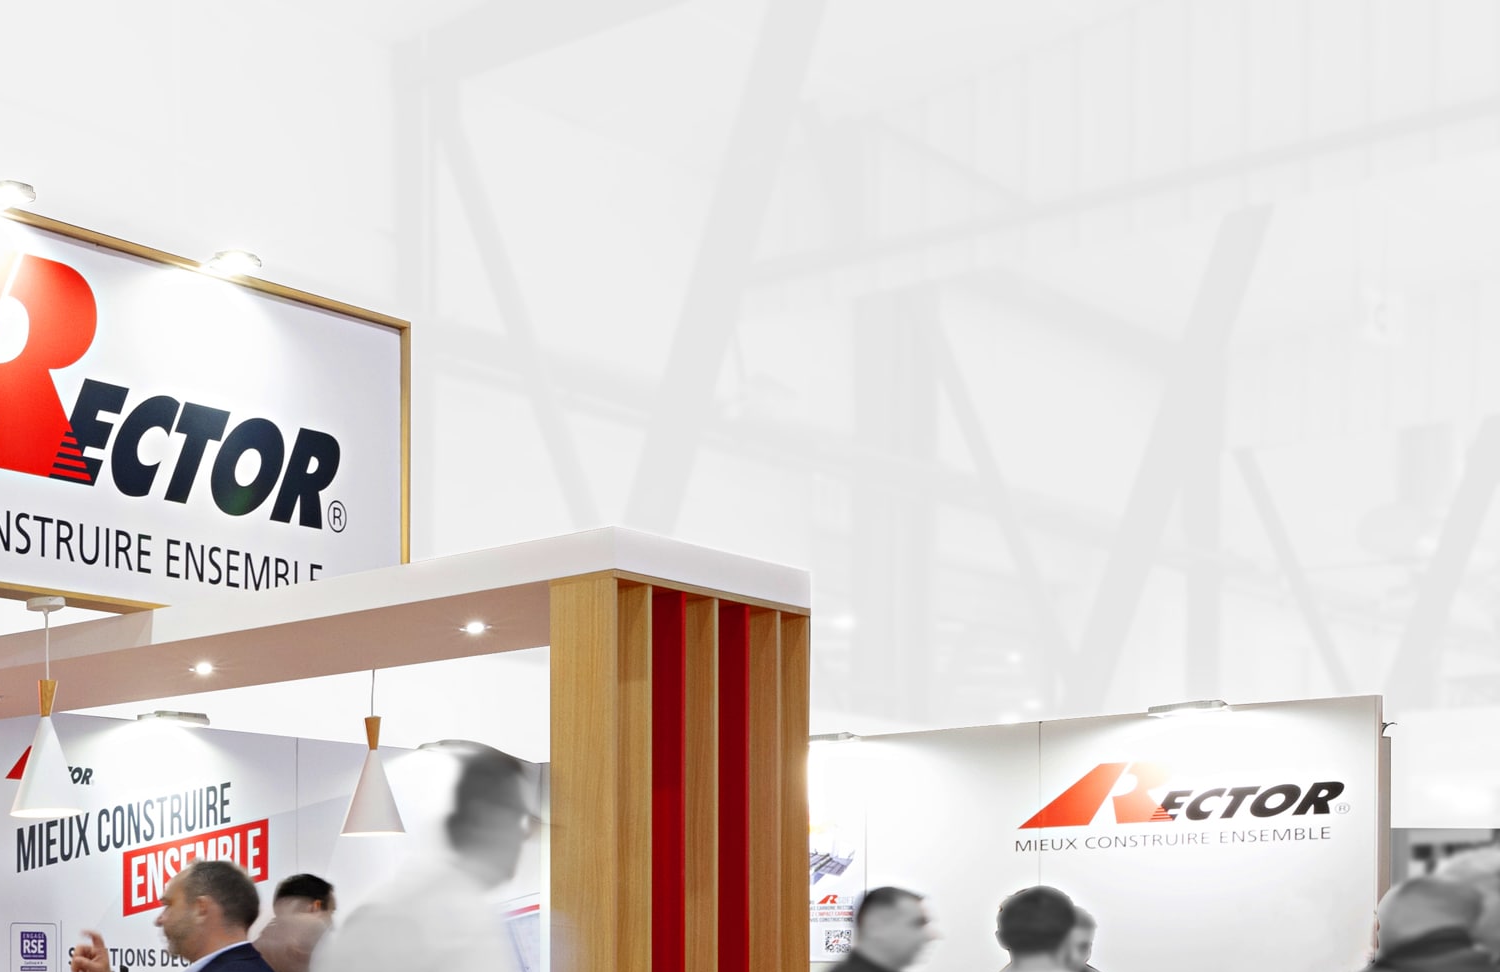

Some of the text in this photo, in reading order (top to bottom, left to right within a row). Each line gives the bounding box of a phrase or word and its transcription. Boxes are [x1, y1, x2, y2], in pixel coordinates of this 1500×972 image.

[16, 782, 231, 873] MIEUX CONSTRUIRE
[1015, 826, 1331, 853] MIEUX CONSTRUIRE ENSEMBLE
[23, 939, 45, 954] RSE
